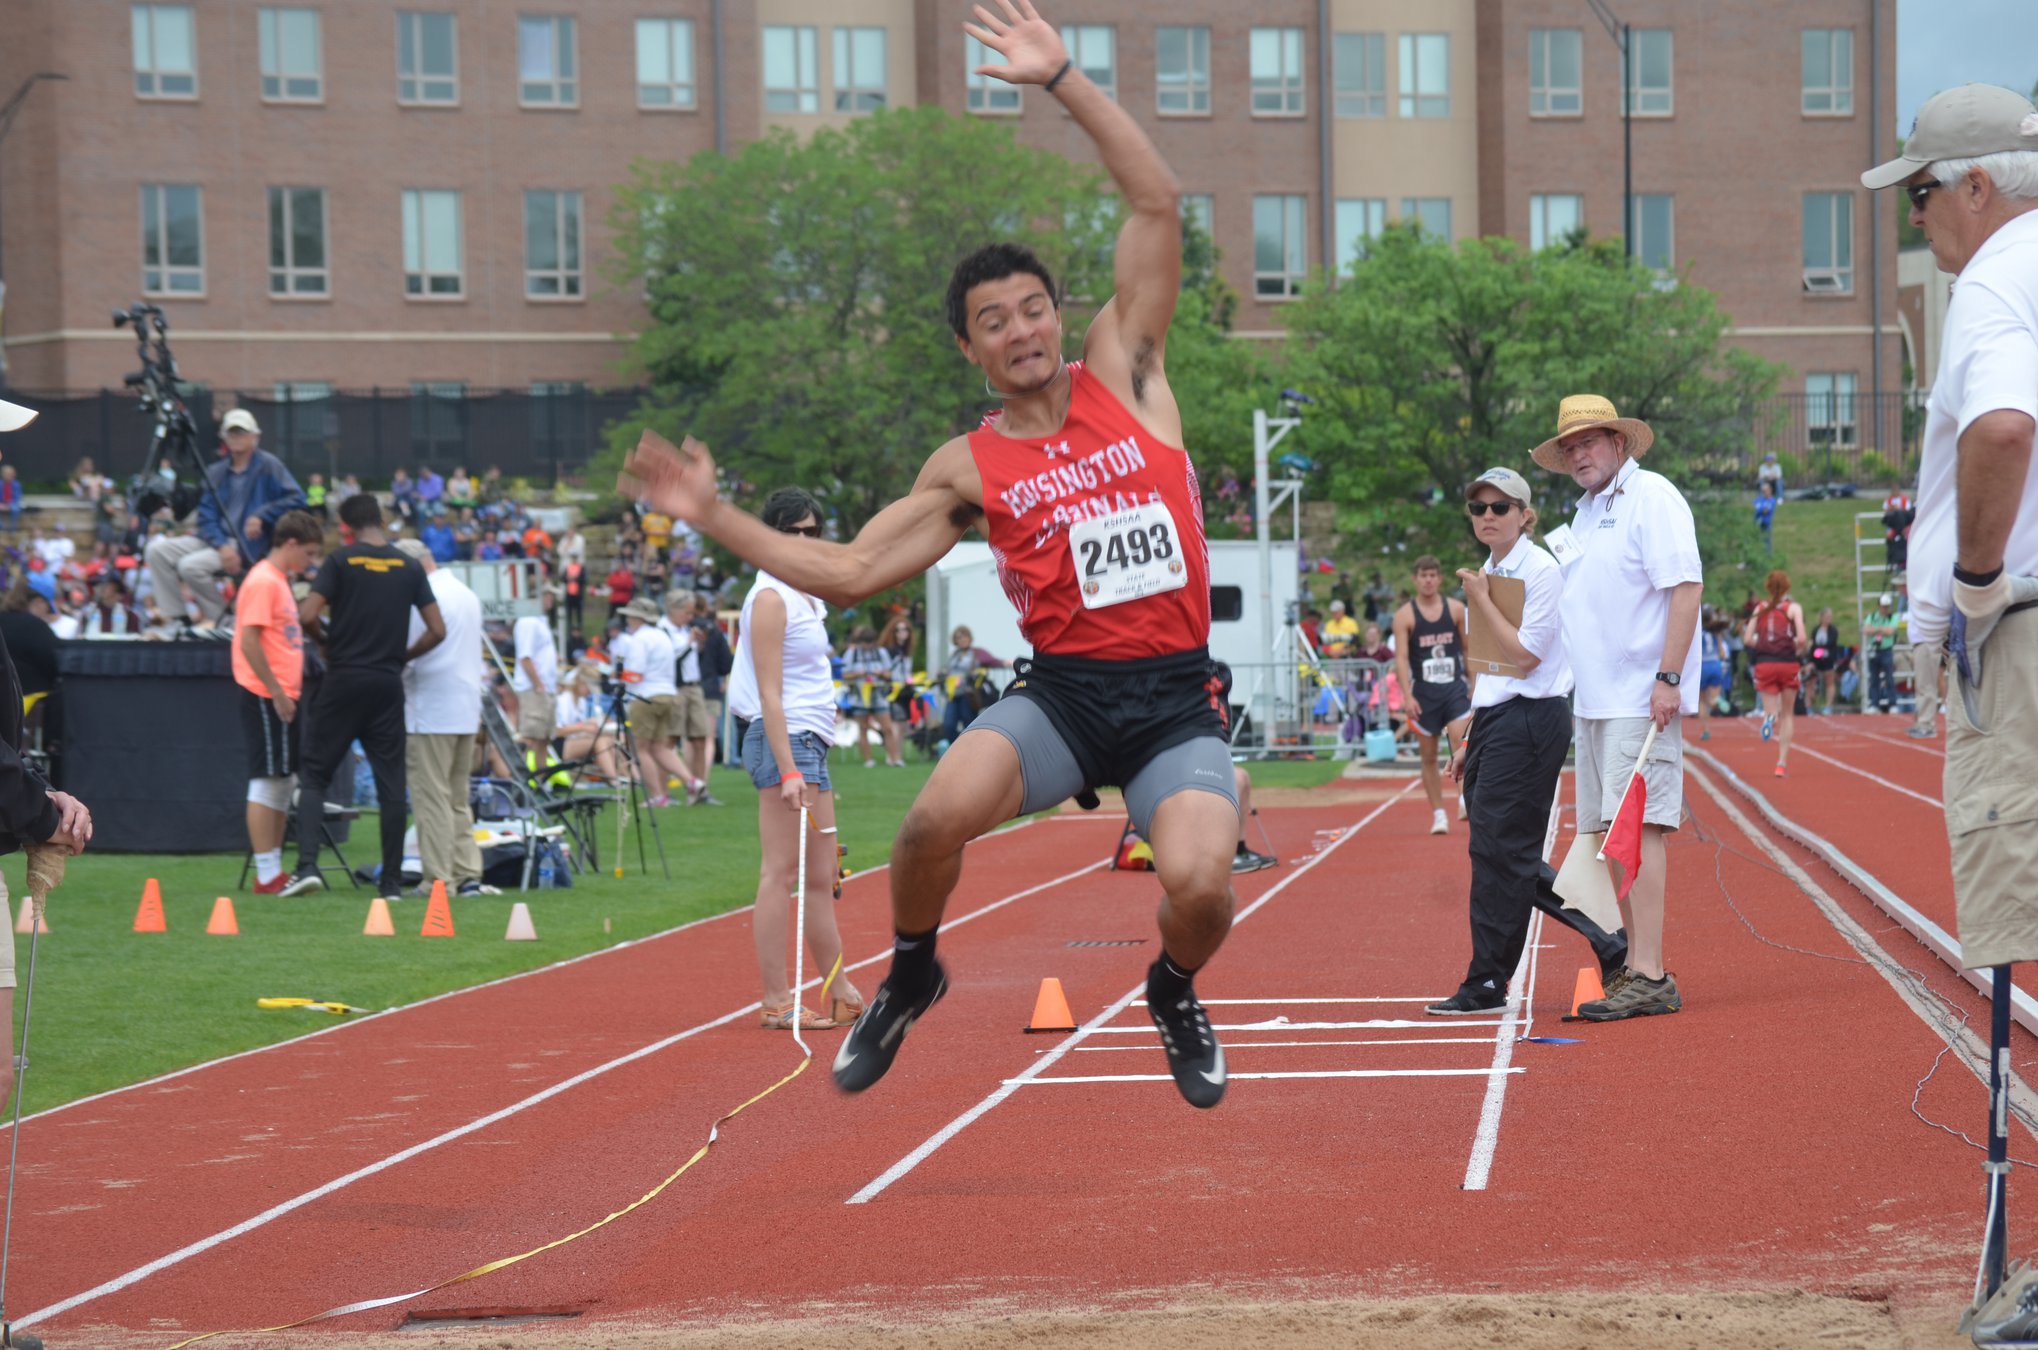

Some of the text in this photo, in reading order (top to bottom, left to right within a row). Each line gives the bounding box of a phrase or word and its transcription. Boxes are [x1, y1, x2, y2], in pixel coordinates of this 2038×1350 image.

[1001, 436, 1146, 519] HOISINGTON
[1104, 513, 1142, 529] KSHSAA
[1080, 524, 1173, 577] 2493
